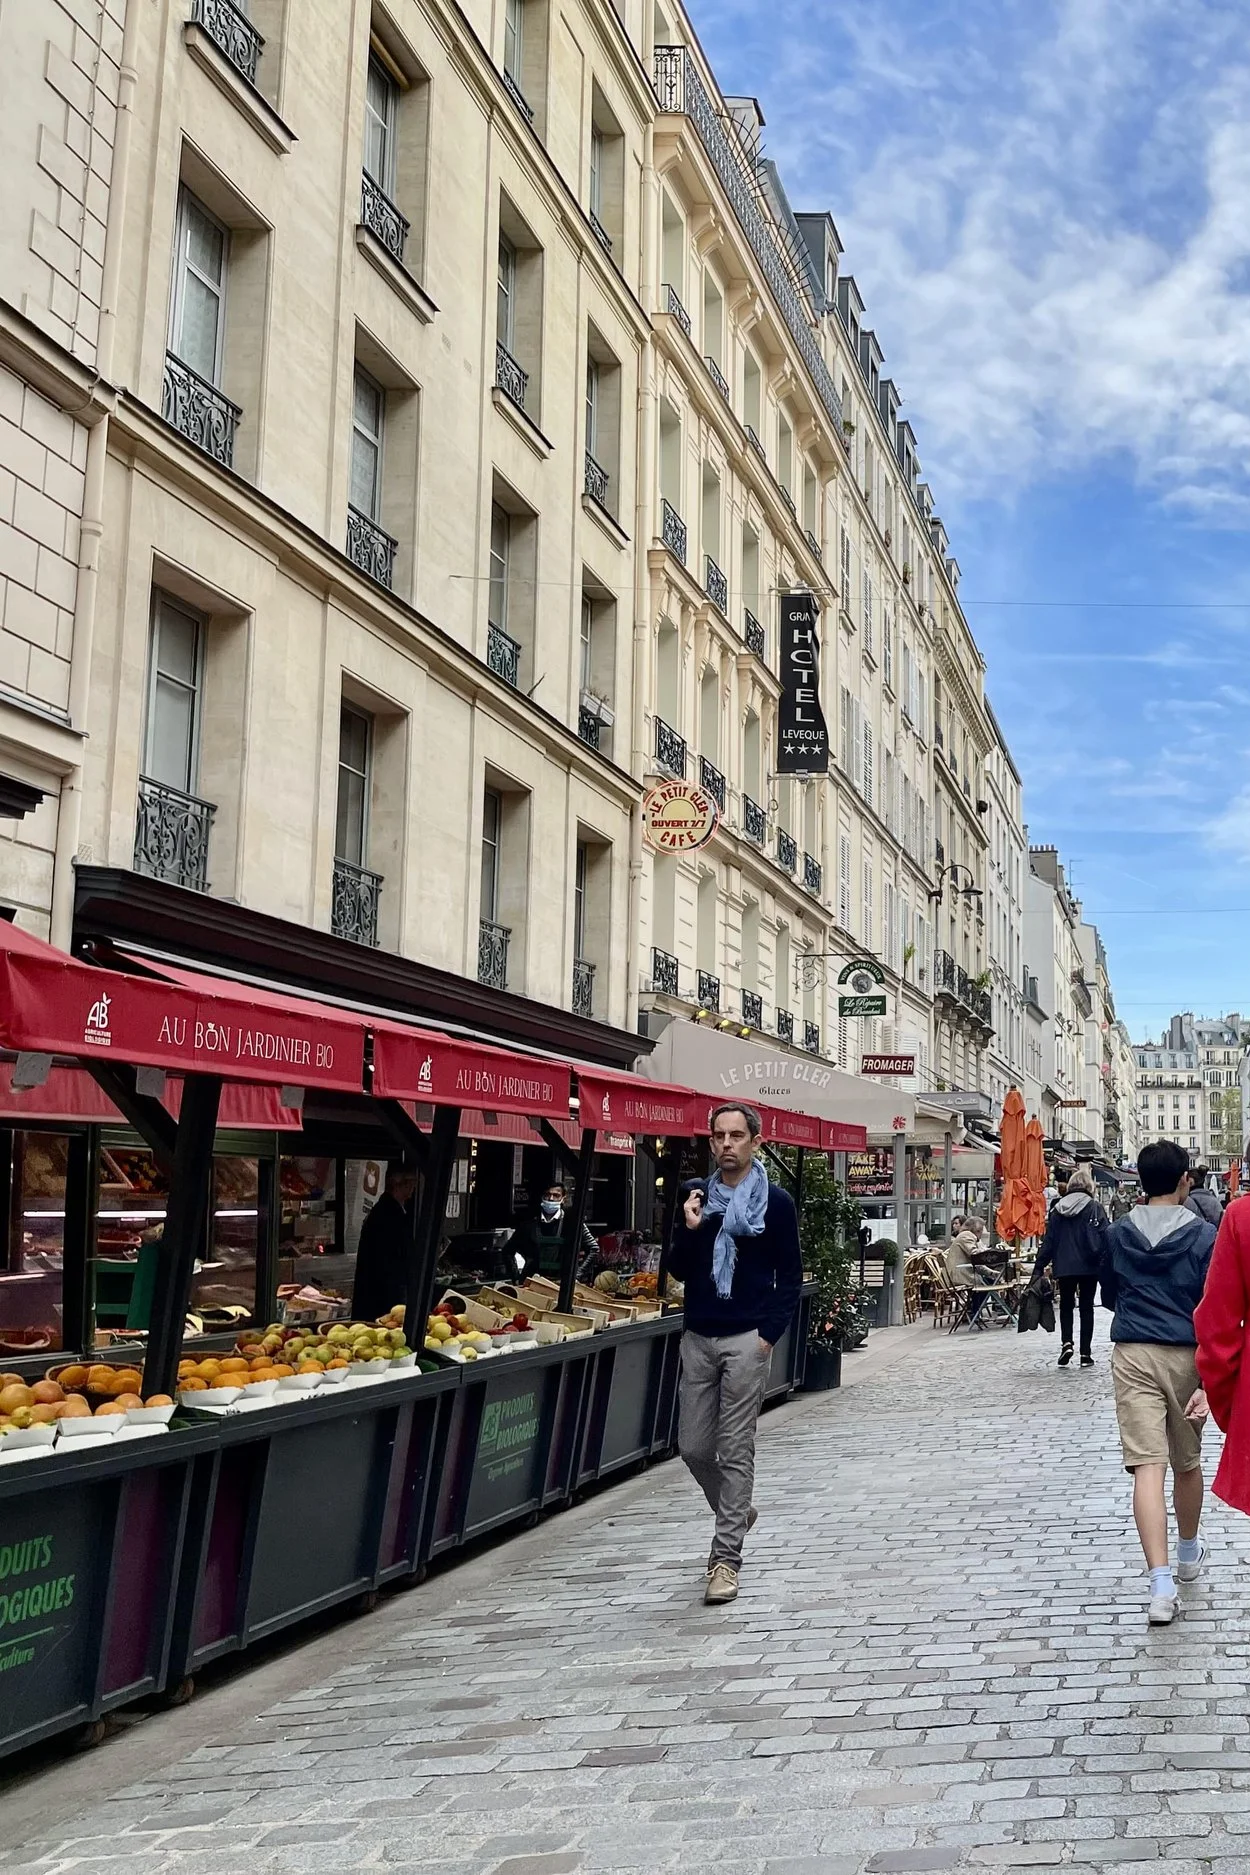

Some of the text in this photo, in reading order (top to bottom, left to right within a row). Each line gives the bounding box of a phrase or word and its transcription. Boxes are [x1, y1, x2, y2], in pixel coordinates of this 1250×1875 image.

[790, 629, 815, 723] HOTEL
[782, 729, 825, 741] LEVEQUE
[649, 786, 709, 814] LE PETIT CLER
[651, 819, 706, 828] OUVERT 7/7
[157, 1015, 334, 1069] AU BON JARDINIER BIO
[862, 1058, 914, 1071] FROMAGER
[719, 1061, 832, 1089] LE PETIT CLER
[456, 1069, 472, 1090] AU
[475, 1071, 496, 1093] BON
[498, 1075, 541, 1101] JARDINIER
[542, 1082, 554, 1102] BIO
[758, 1086, 792, 1096] Glaces
[850, 1154, 876, 1165] TAKE
[848, 1165, 876, 1176] AWAY
